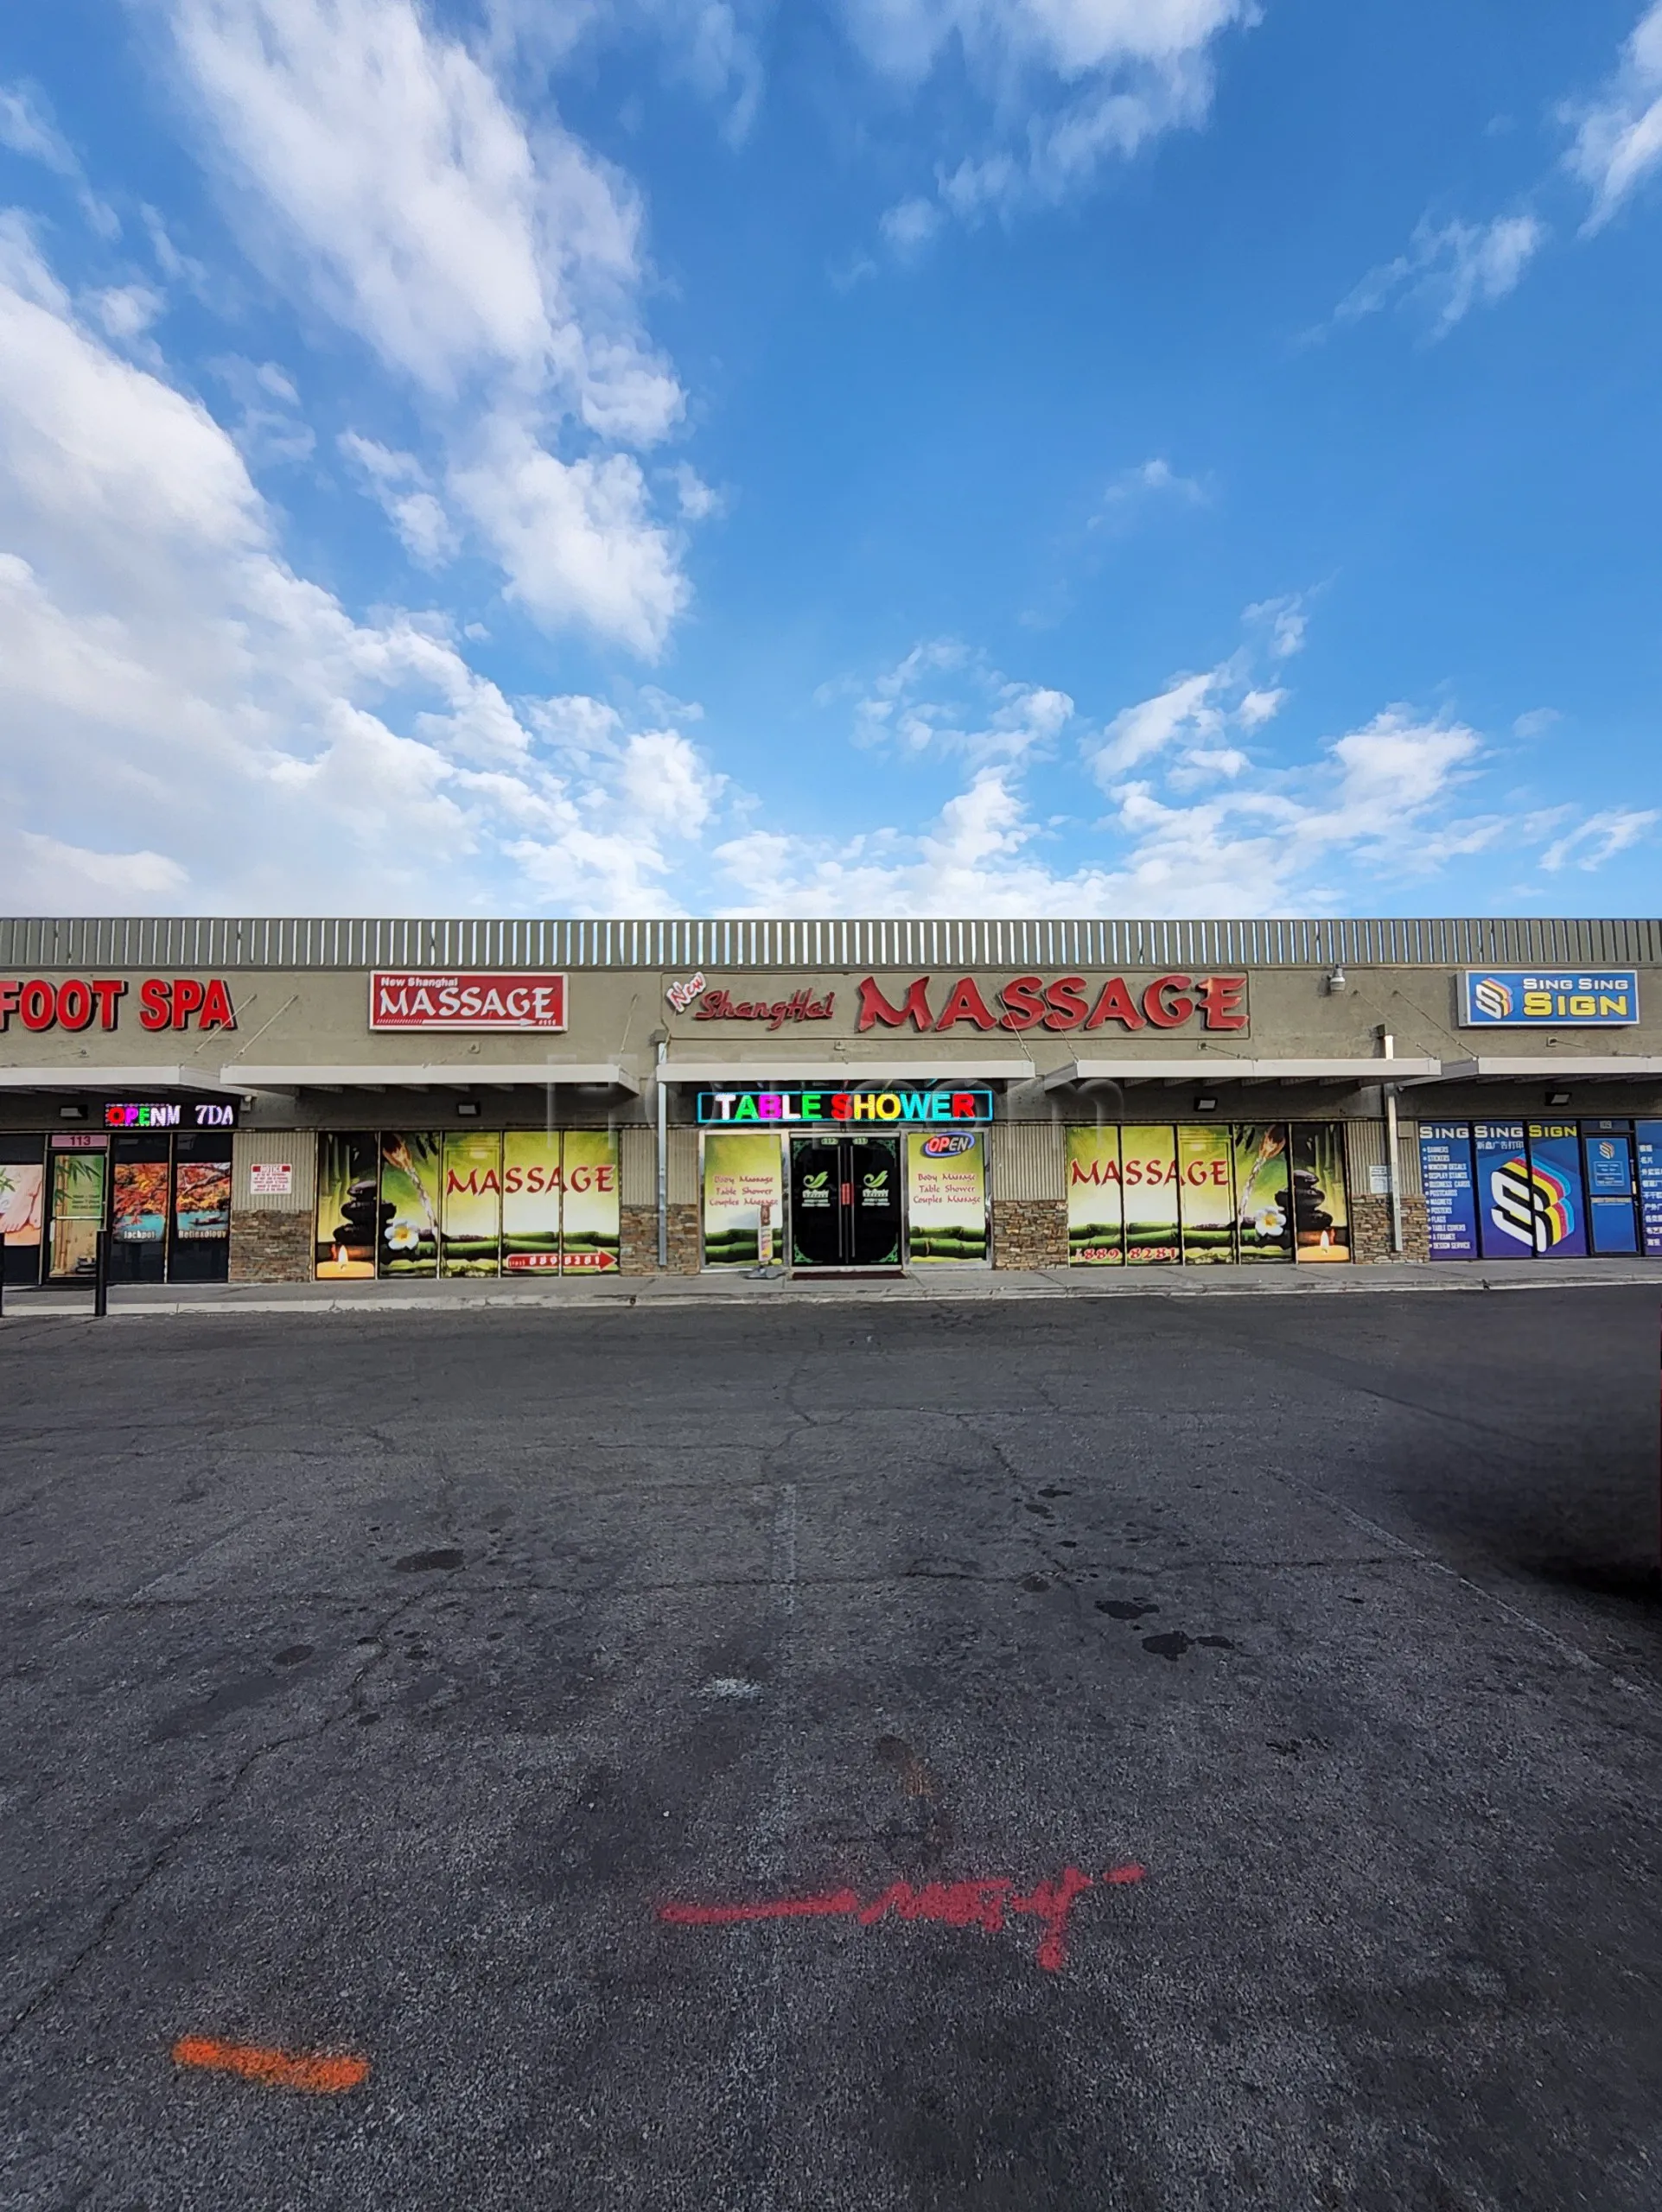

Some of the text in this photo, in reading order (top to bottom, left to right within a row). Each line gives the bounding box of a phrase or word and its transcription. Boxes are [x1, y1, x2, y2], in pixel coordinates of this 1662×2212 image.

[380, 977, 458, 988] New Shanghai
[666, 971, 706, 1013] New
[1524, 978, 1628, 990] SING SING
[0, 979, 235, 1031] FOOT SPA
[380, 987, 554, 1019] MASSAGE
[858, 975, 1250, 1031] MASSAGE
[1524, 991, 1627, 1016] SIGN
[716, 1093, 974, 1121] TABLE SHOWER
[69, 1135, 92, 1146] 113
[928, 1136, 969, 1152] OPEN
[1419, 1125, 1576, 1139] SING SING SIGN
[446, 1166, 615, 1196] MASSAGE
[1071, 1159, 1230, 1186] MASSAGE
[913, 1196, 942, 1205] Couples
[1084, 1248, 1120, 1261] 889
[1129, 1248, 1177, 1261] 8281
